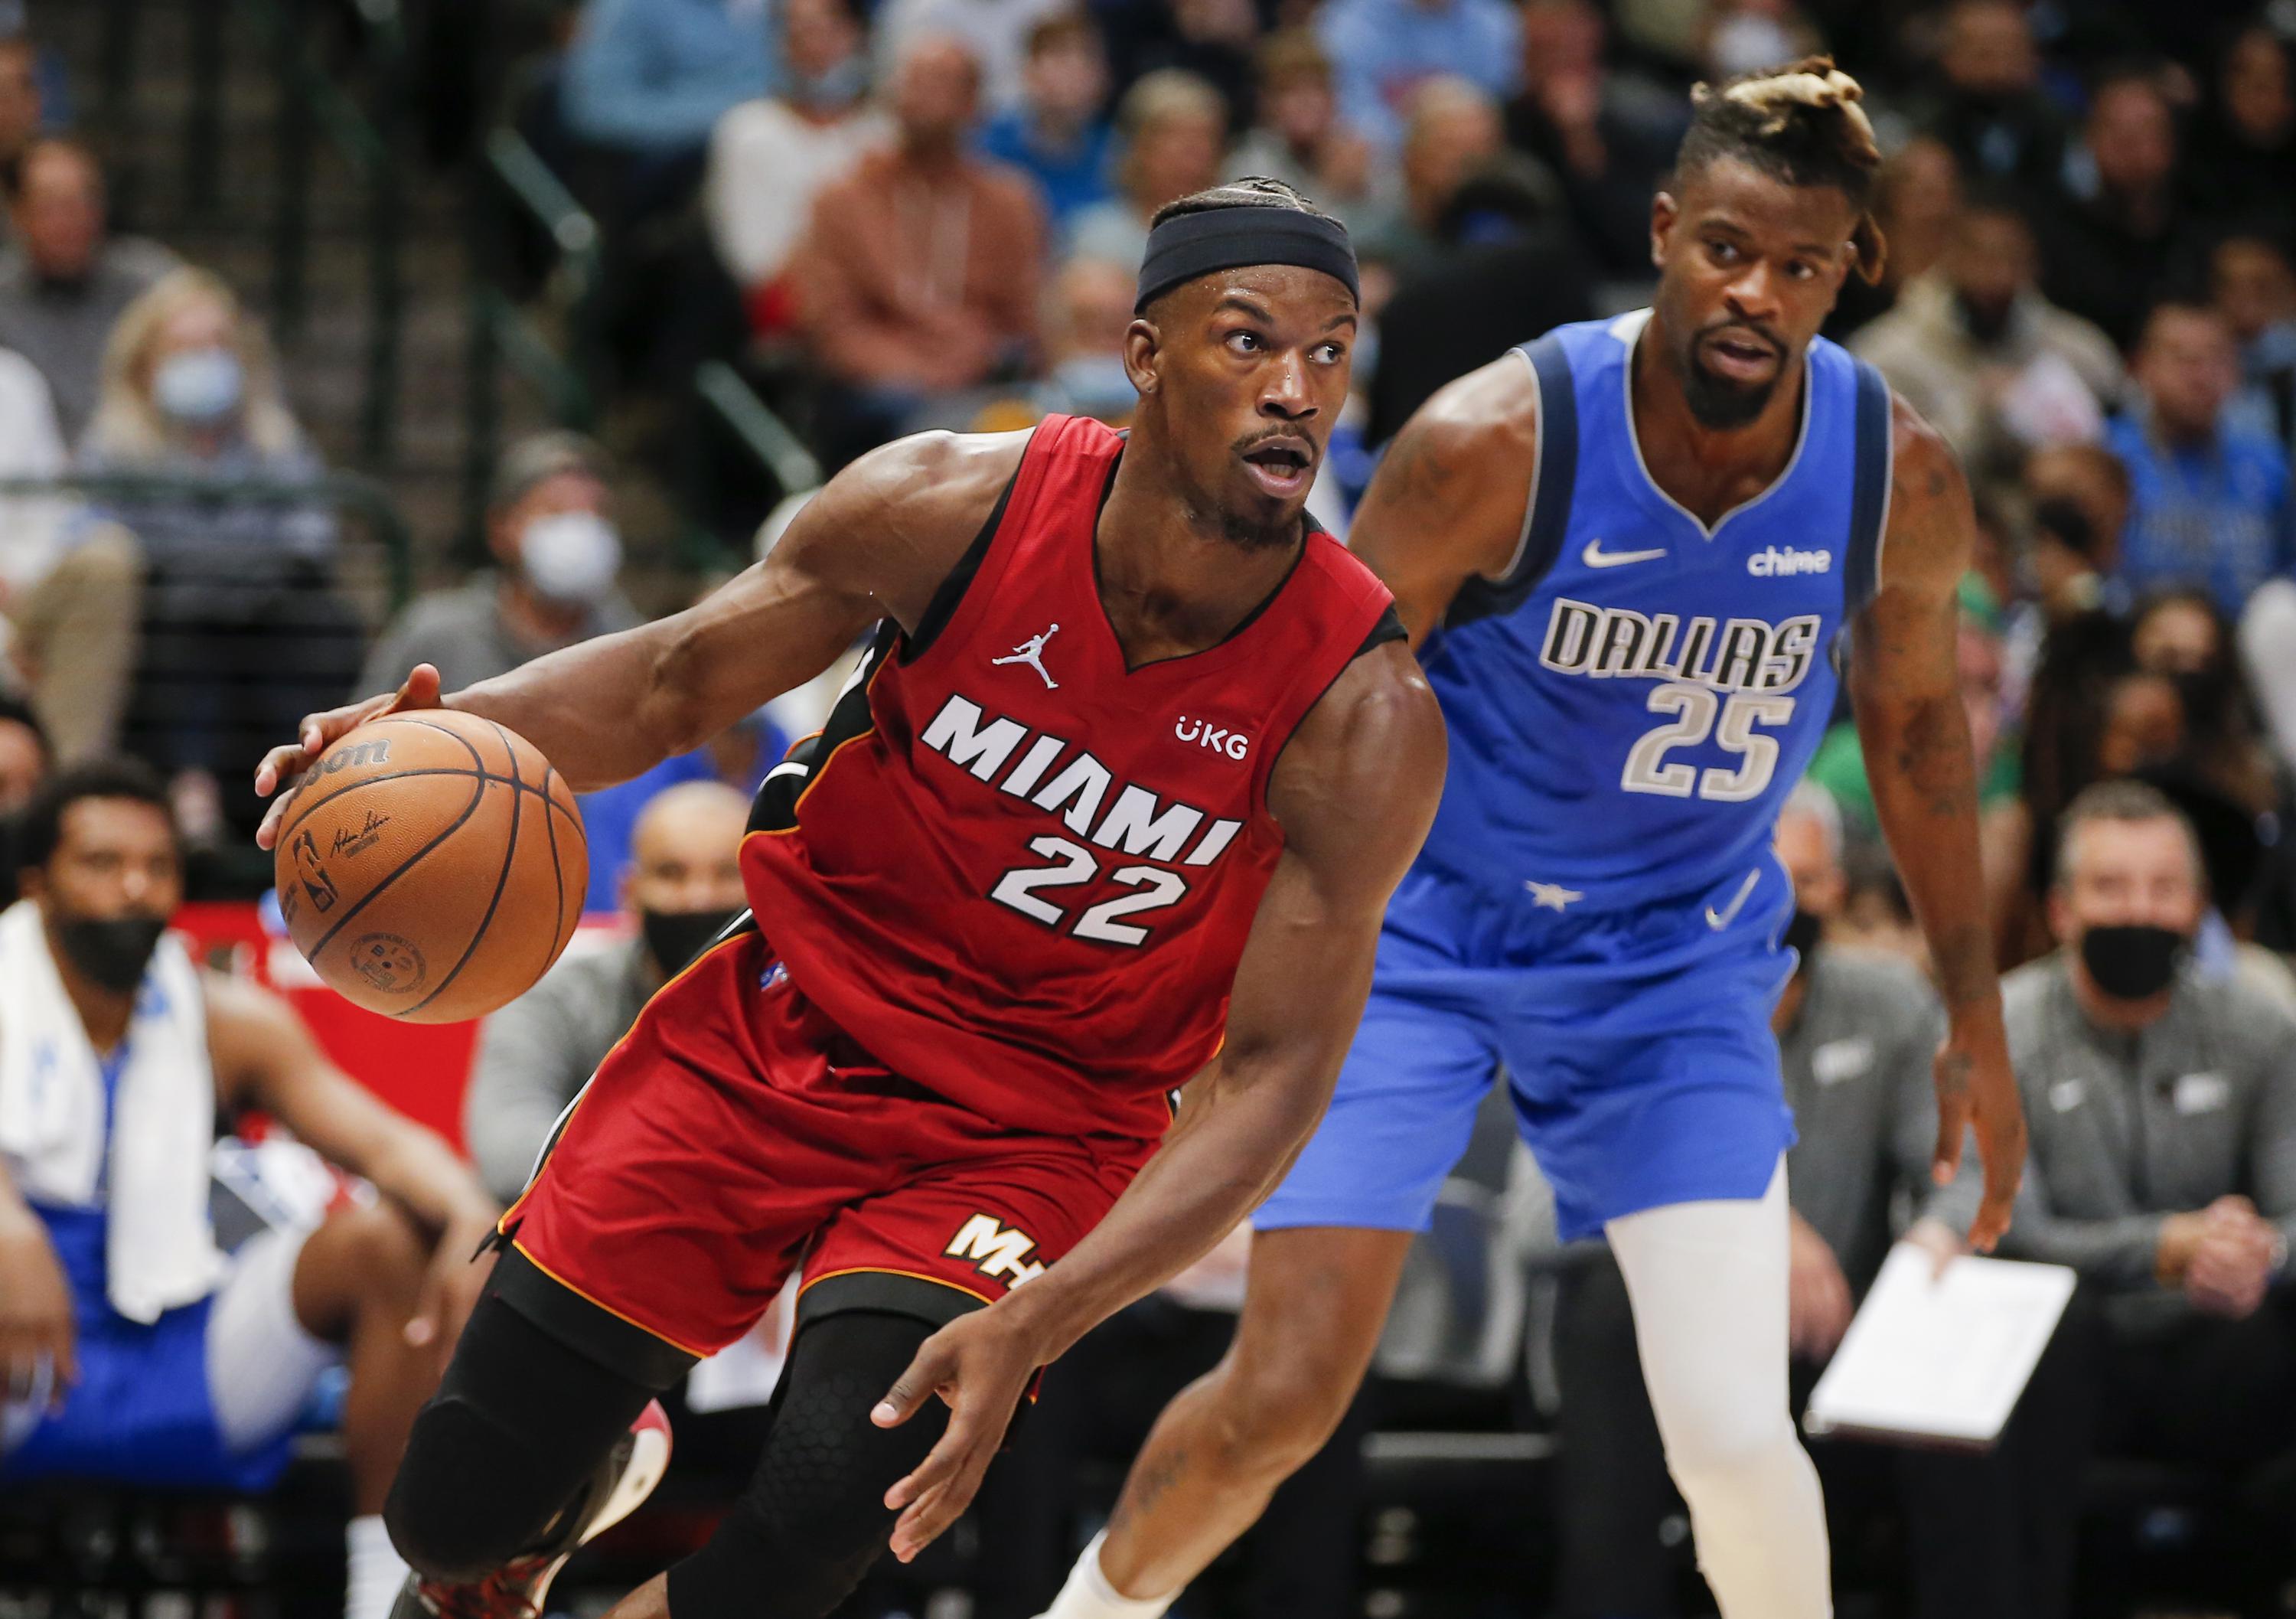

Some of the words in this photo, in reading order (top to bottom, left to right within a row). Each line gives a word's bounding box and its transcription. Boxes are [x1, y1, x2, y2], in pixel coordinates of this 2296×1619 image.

[1746, 544, 1831, 577] chime
[1539, 596, 1822, 696] DALLAS
[919, 692, 1245, 868] MIAMI
[1620, 683, 1796, 803] 25
[990, 835, 1189, 948] 22
